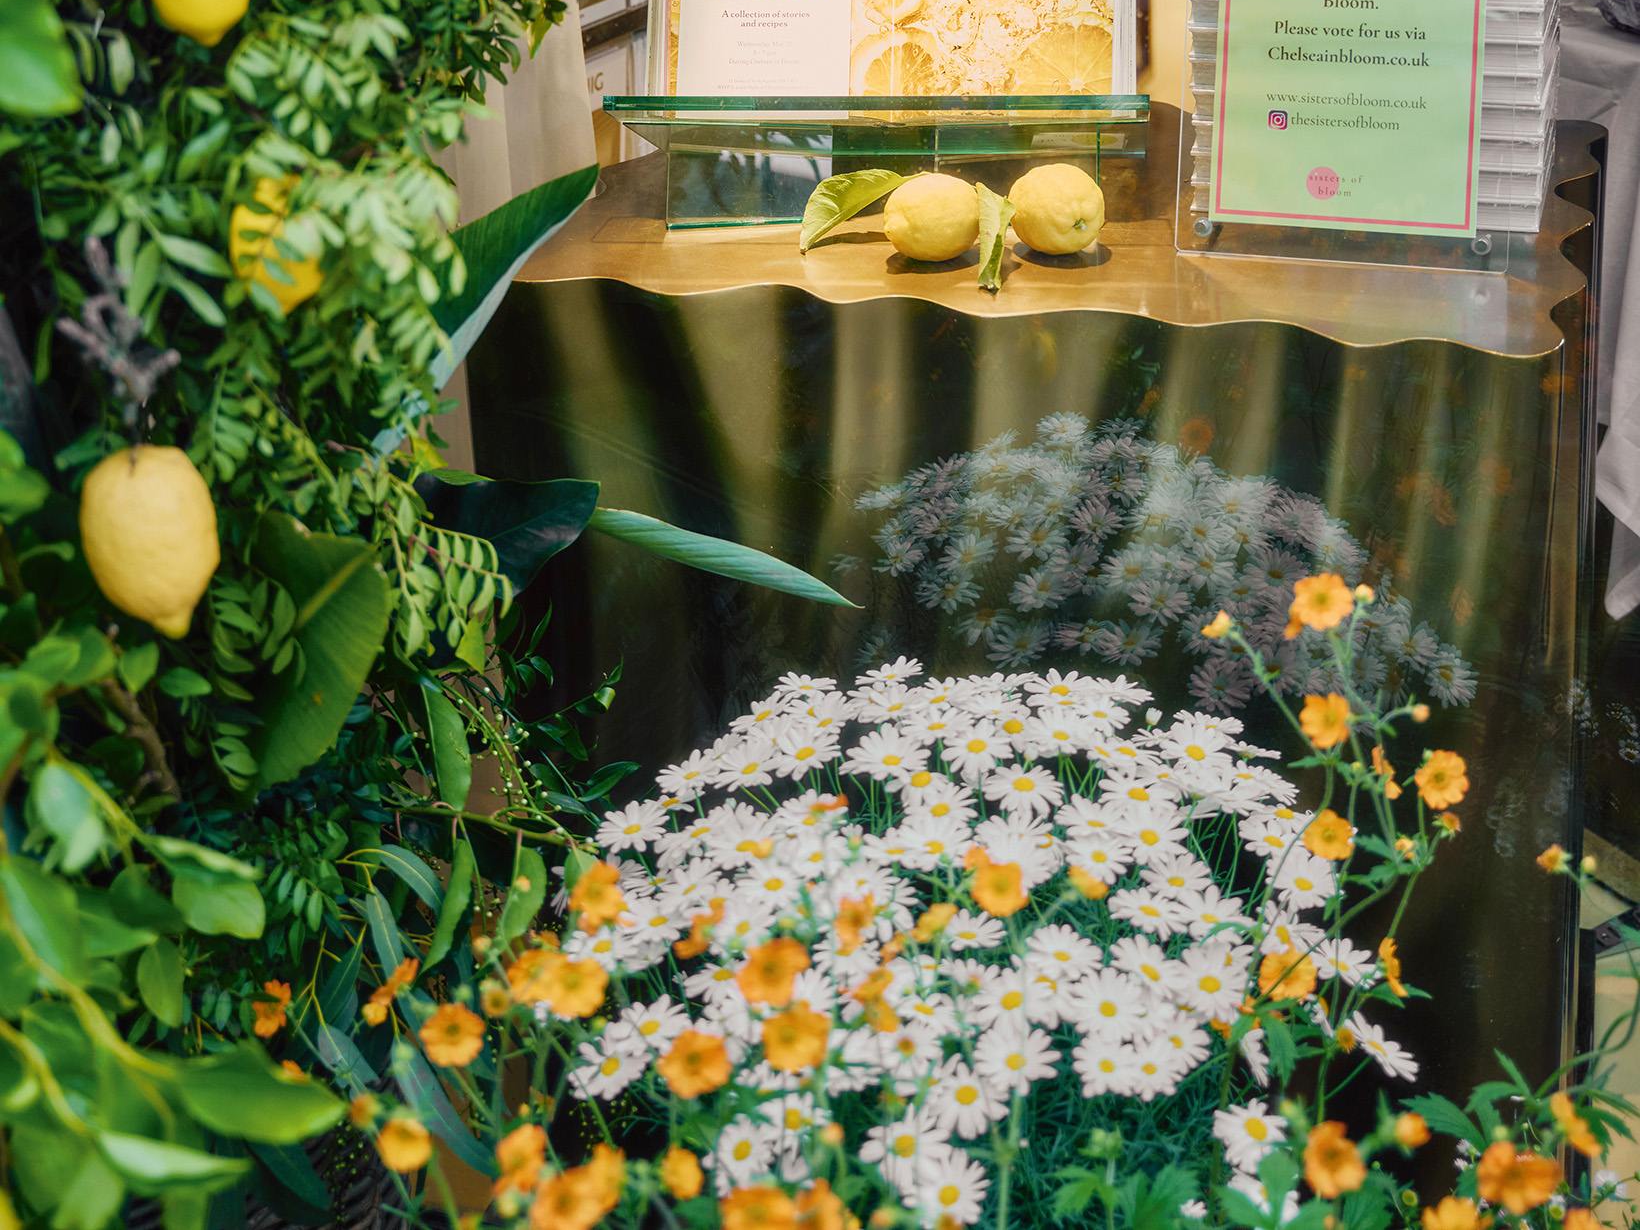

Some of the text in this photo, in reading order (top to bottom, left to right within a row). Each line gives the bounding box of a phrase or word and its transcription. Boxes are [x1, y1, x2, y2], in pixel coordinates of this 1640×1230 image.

[722, 10, 729, 18] A
[731, 10, 770, 18] collection
[772, 10, 780, 18] of
[758, 20, 788, 29] recipes
[1274, 20, 1426, 40] Please vote for us via
[1268, 46, 1430, 67] Chelseainbloom.co.uk
[1266, 93, 1427, 110] www.sistersofbloom.co.uk
[1291, 112, 1400, 131] thesistersofbloom
[1309, 173, 1363, 184] sisters of
[1318, 187, 1352, 197] bloom
